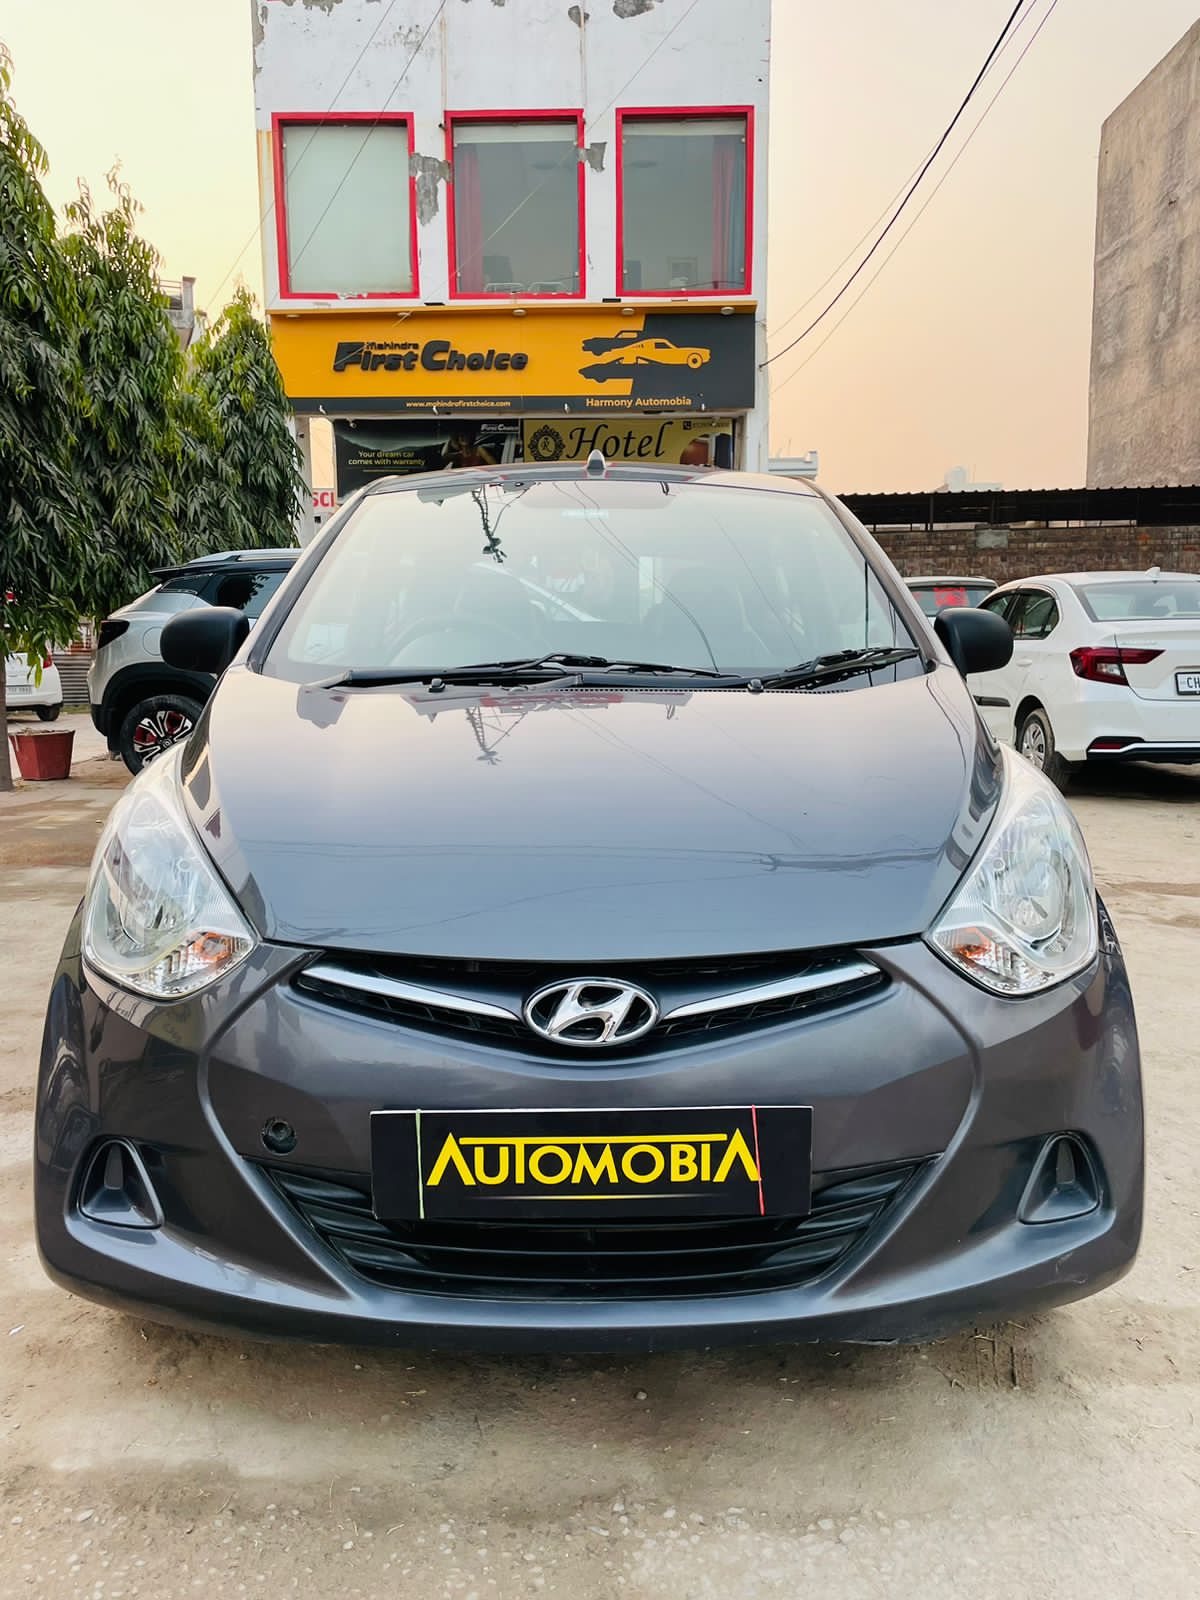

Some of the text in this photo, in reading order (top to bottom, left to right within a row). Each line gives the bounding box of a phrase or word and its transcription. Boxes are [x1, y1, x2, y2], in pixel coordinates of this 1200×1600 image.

[333, 340, 529, 372] First Choice
[585, 396, 692, 408] Harmony Automobia
[566, 420, 674, 459] Hotel
[426, 1127, 761, 1186] AUTOMOBIA
